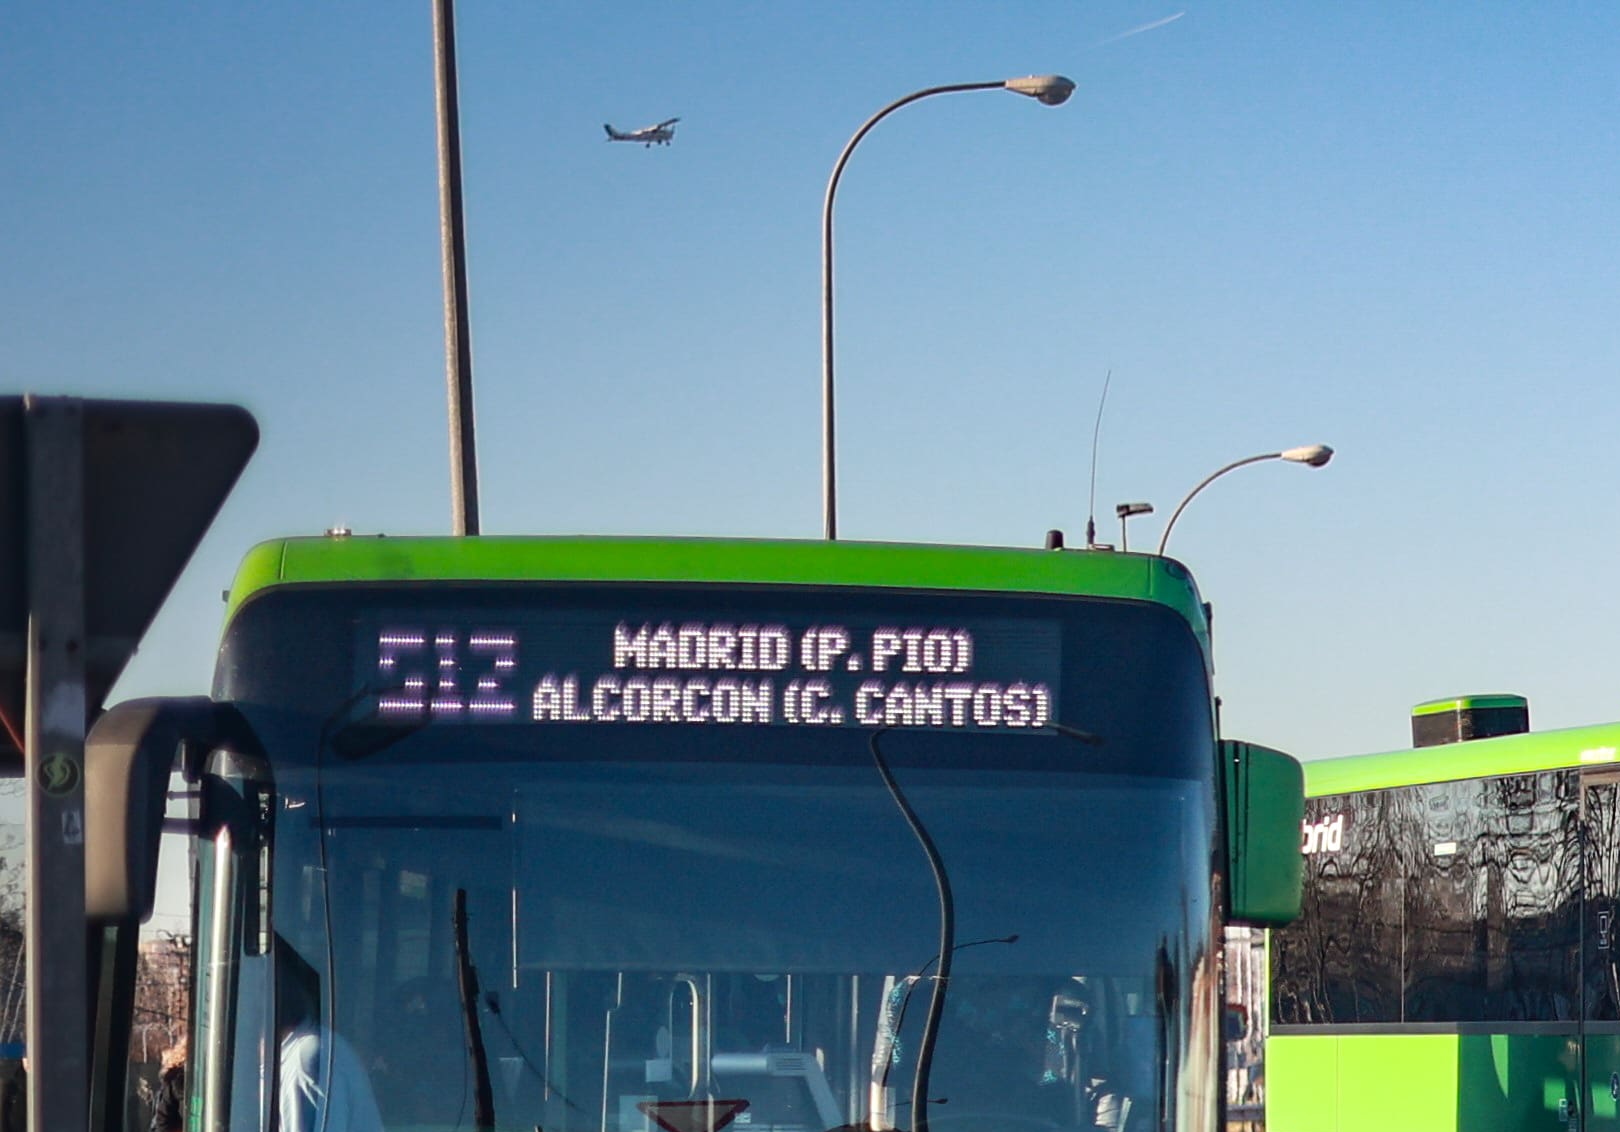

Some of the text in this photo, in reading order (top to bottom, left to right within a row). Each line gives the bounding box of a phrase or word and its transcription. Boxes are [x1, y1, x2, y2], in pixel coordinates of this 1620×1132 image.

[614, 622, 972, 674] MADRID (P. PIO)
[533, 677, 1049, 728] ALCORCON (C. CANTOS)
